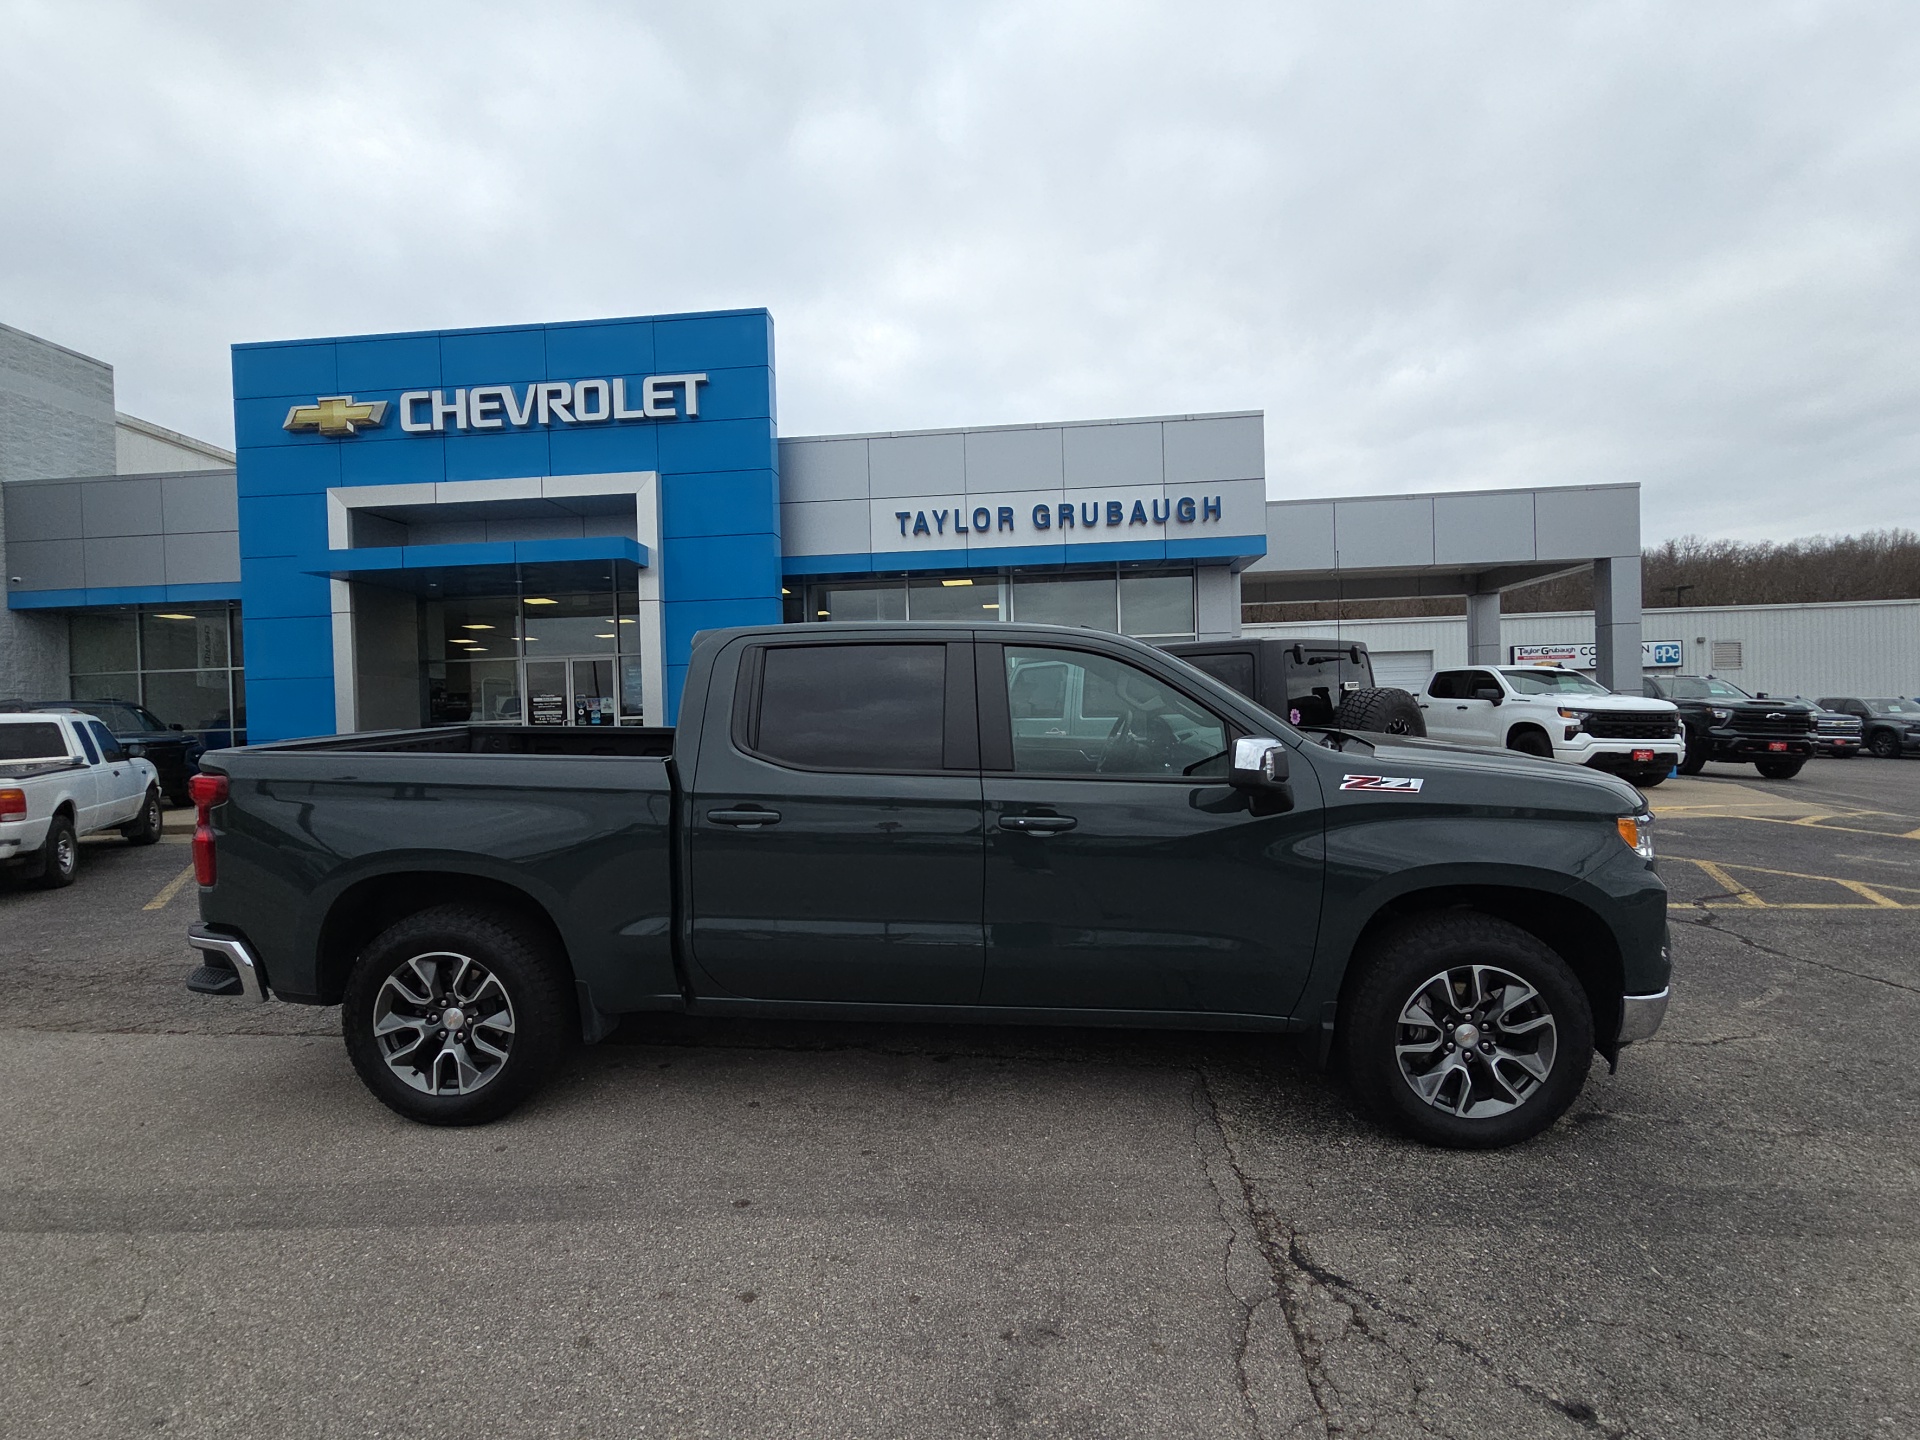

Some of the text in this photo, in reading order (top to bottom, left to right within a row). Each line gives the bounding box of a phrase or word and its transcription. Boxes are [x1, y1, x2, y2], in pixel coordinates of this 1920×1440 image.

[400, 373, 707, 432] CHEVROLET
[895, 496, 1222, 536] TAYLOR GRUBAUGH
[1517, 647, 1540, 656] Taylor
[1541, 647, 1576, 655] Grubaugh
[1339, 774, 1424, 793] Z71
